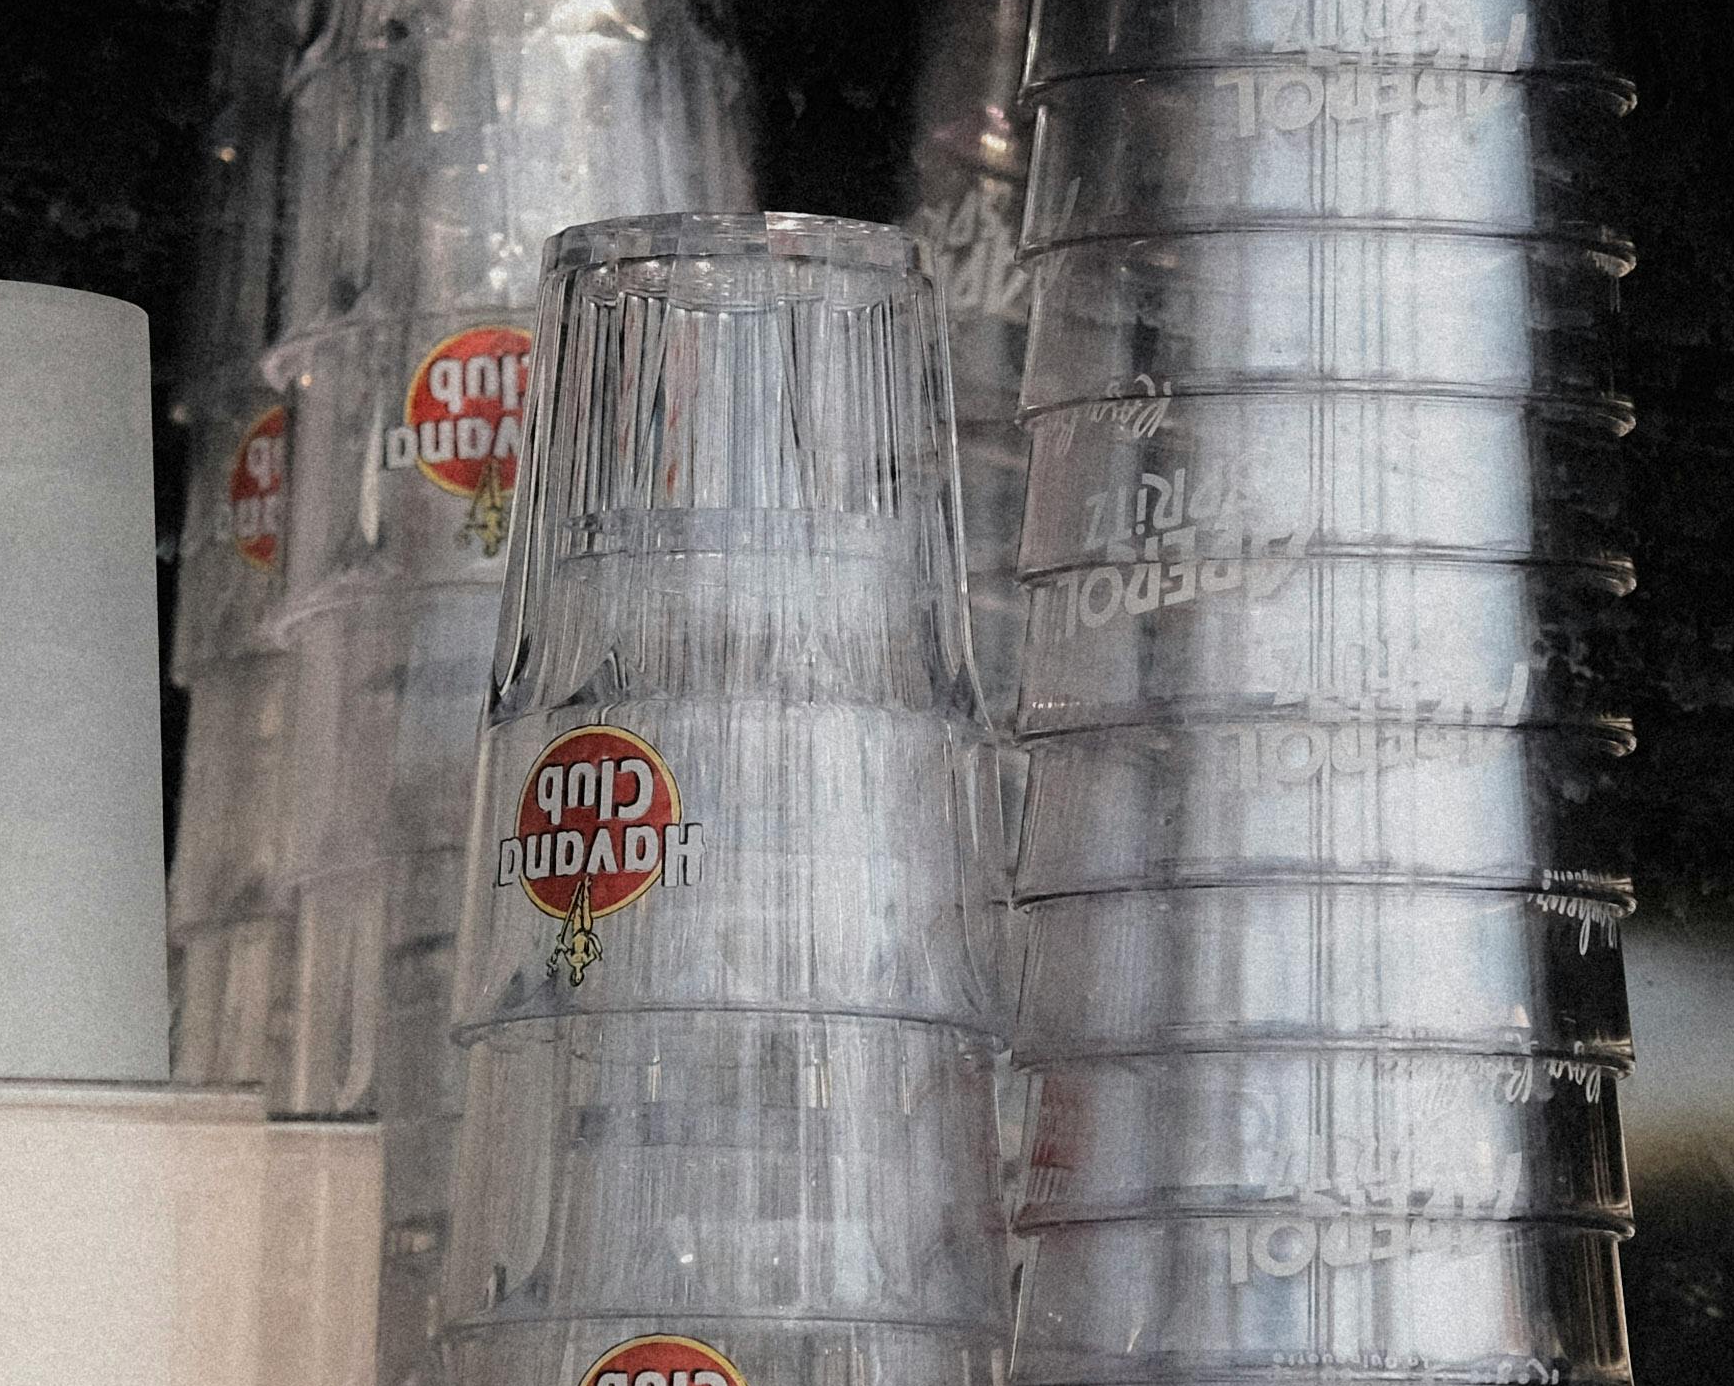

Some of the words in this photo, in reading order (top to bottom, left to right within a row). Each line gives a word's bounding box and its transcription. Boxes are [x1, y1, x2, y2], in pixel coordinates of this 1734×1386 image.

[430, 355, 530, 413] lub
[383, 417, 523, 472] vana
[537, 756, 654, 827] Club
[498, 821, 707, 888] Havana
